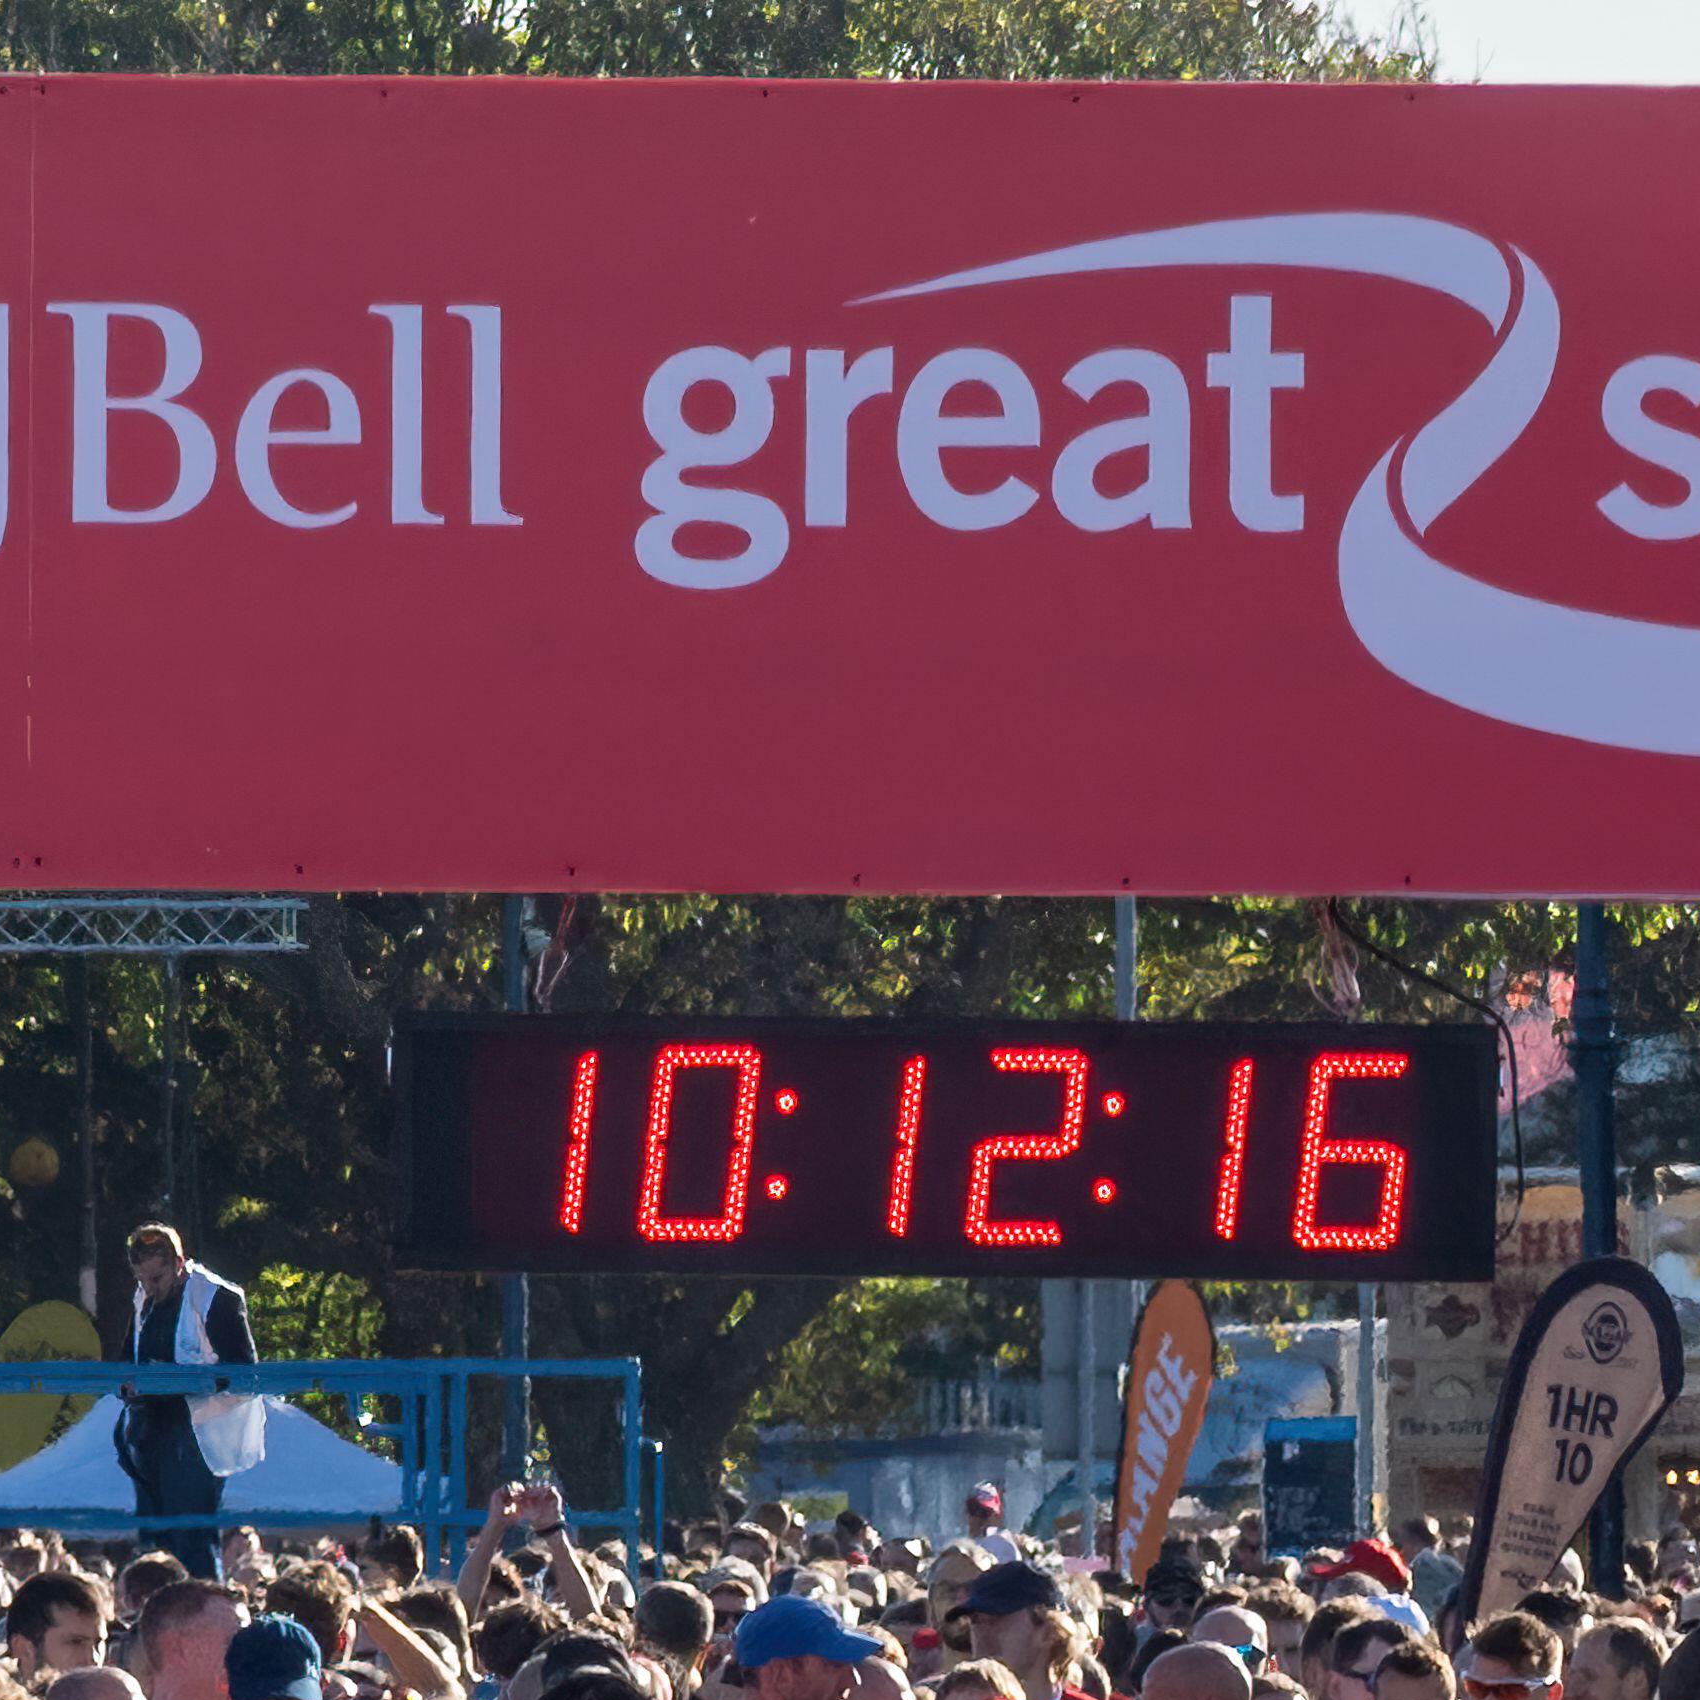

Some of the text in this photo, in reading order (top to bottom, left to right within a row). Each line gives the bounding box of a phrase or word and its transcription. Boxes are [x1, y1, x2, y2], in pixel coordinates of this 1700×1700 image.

[634, 293, 1305, 591] great
[555, 1043, 1410, 1251] 10:12:16
[1547, 1384, 1619, 1438] 1HR
[1555, 1438, 1594, 1487] 10
